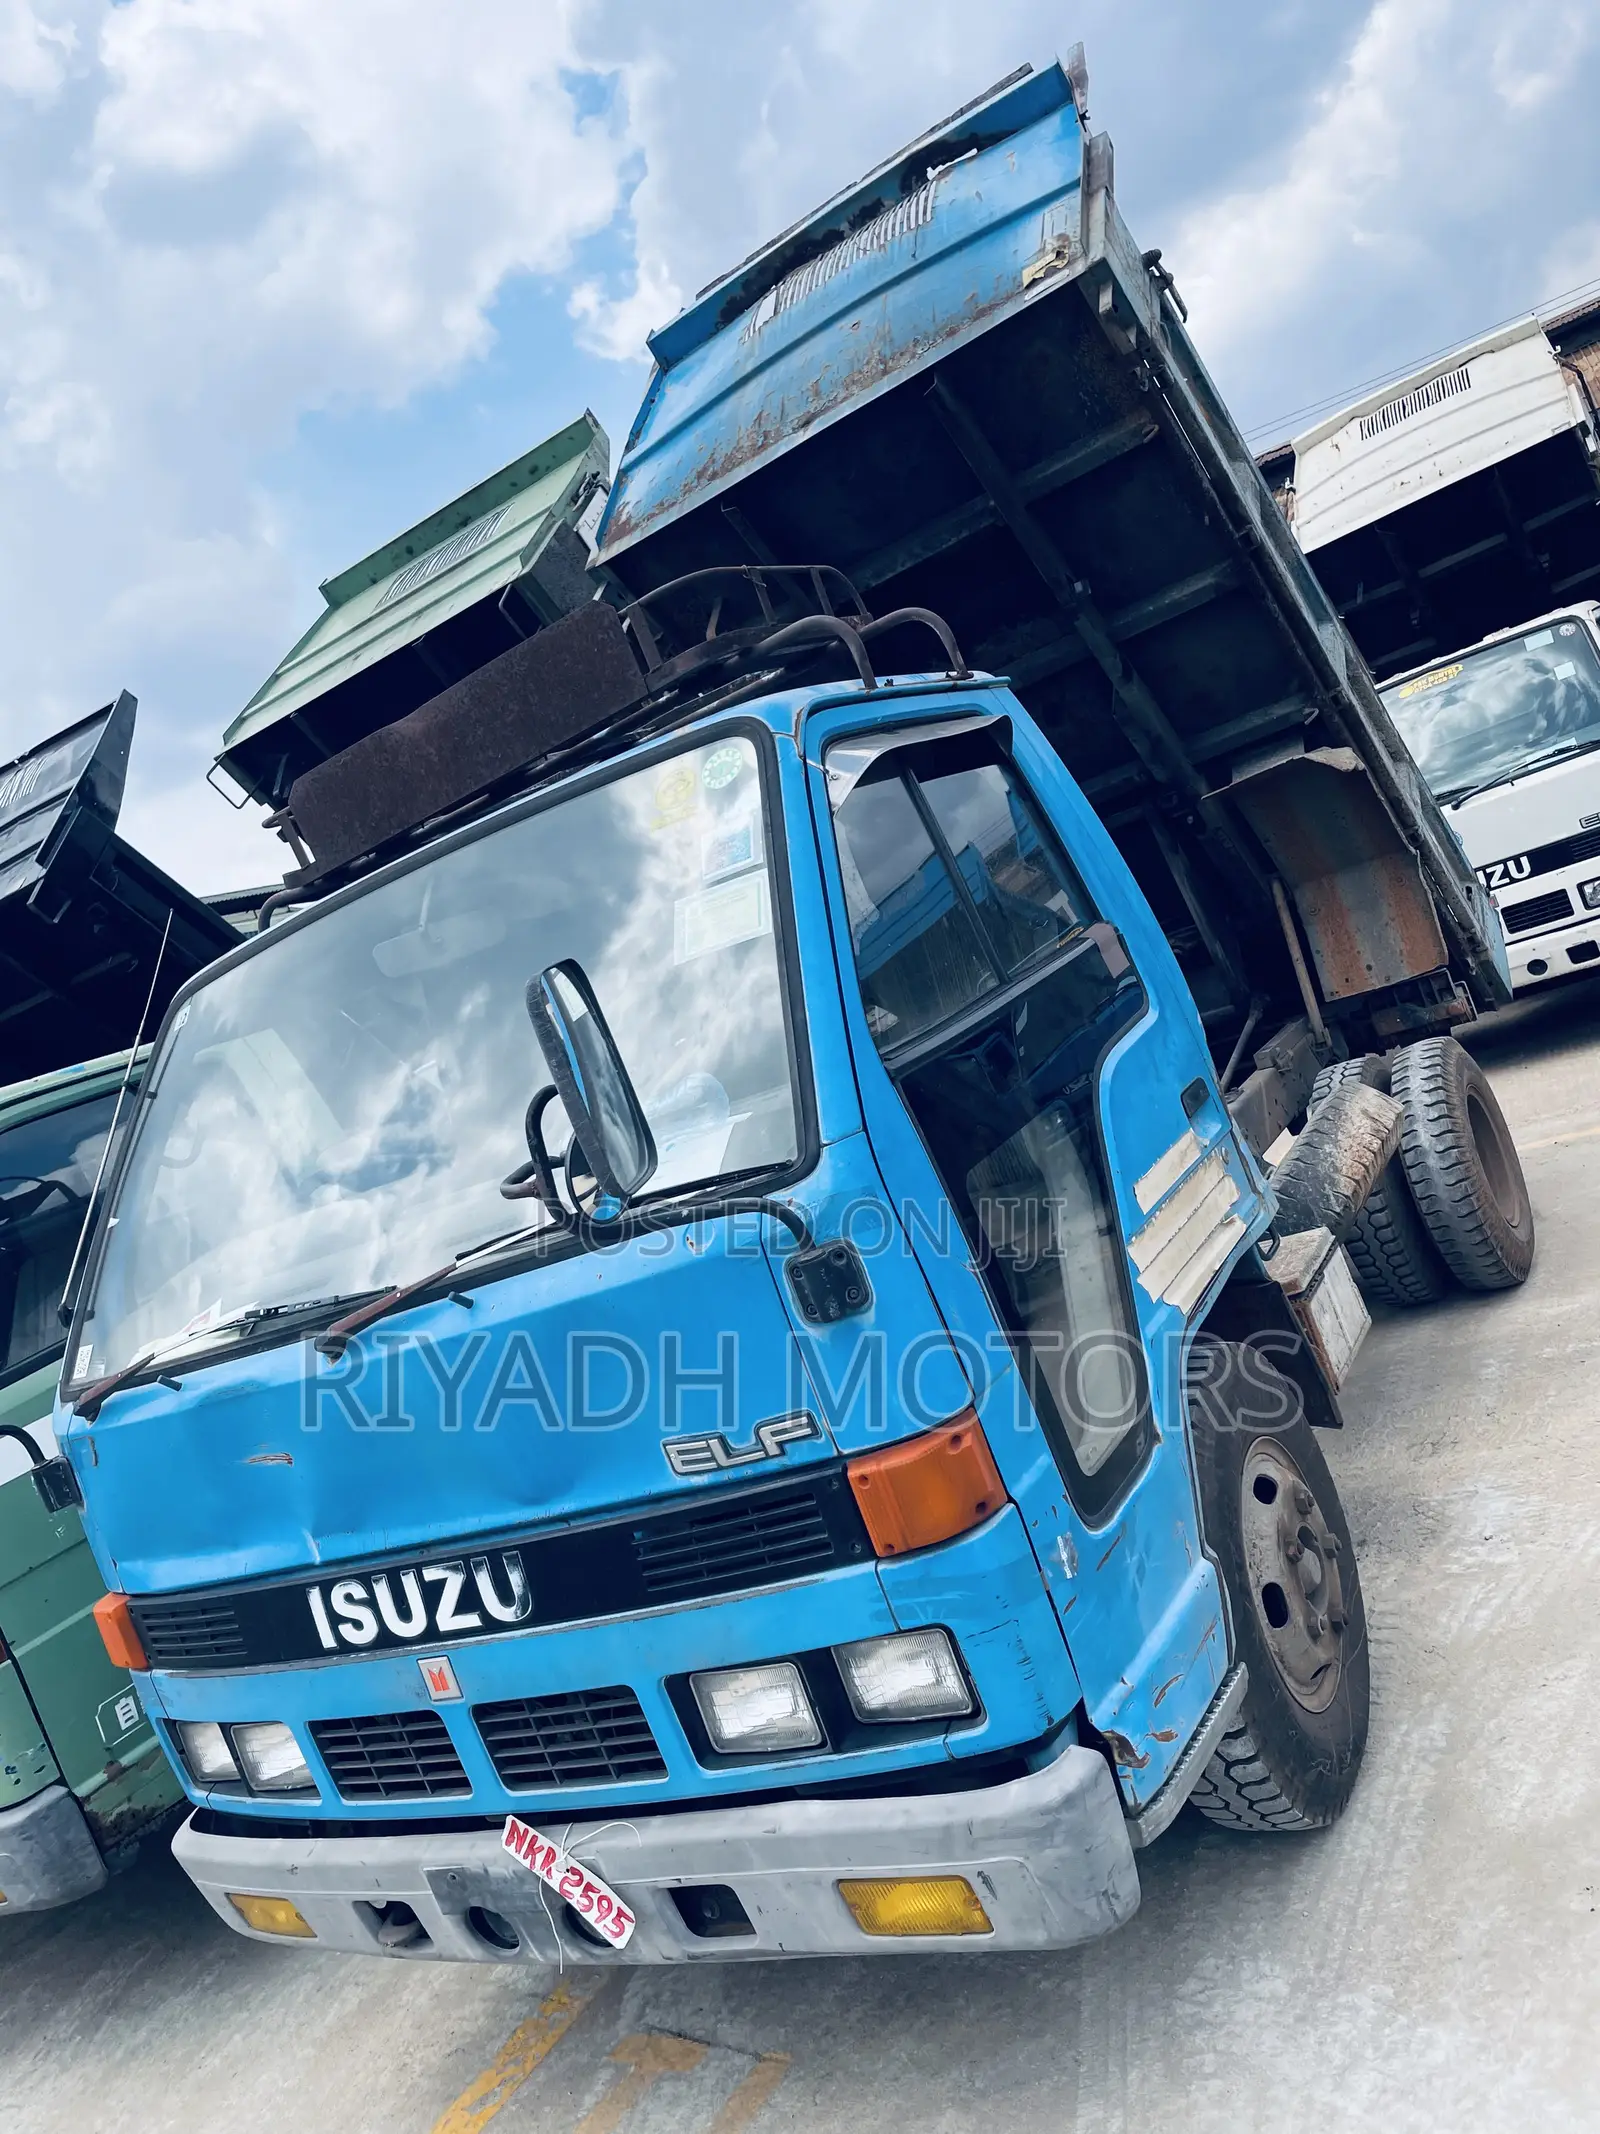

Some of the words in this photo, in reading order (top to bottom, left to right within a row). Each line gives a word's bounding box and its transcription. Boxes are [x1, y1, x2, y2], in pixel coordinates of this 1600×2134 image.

[1579, 811, 1600, 829] E
[663, 1411, 819, 1475] ELF
[305, 1550, 532, 1649] ISUZU
[558, 1866, 636, 1939] 2595
